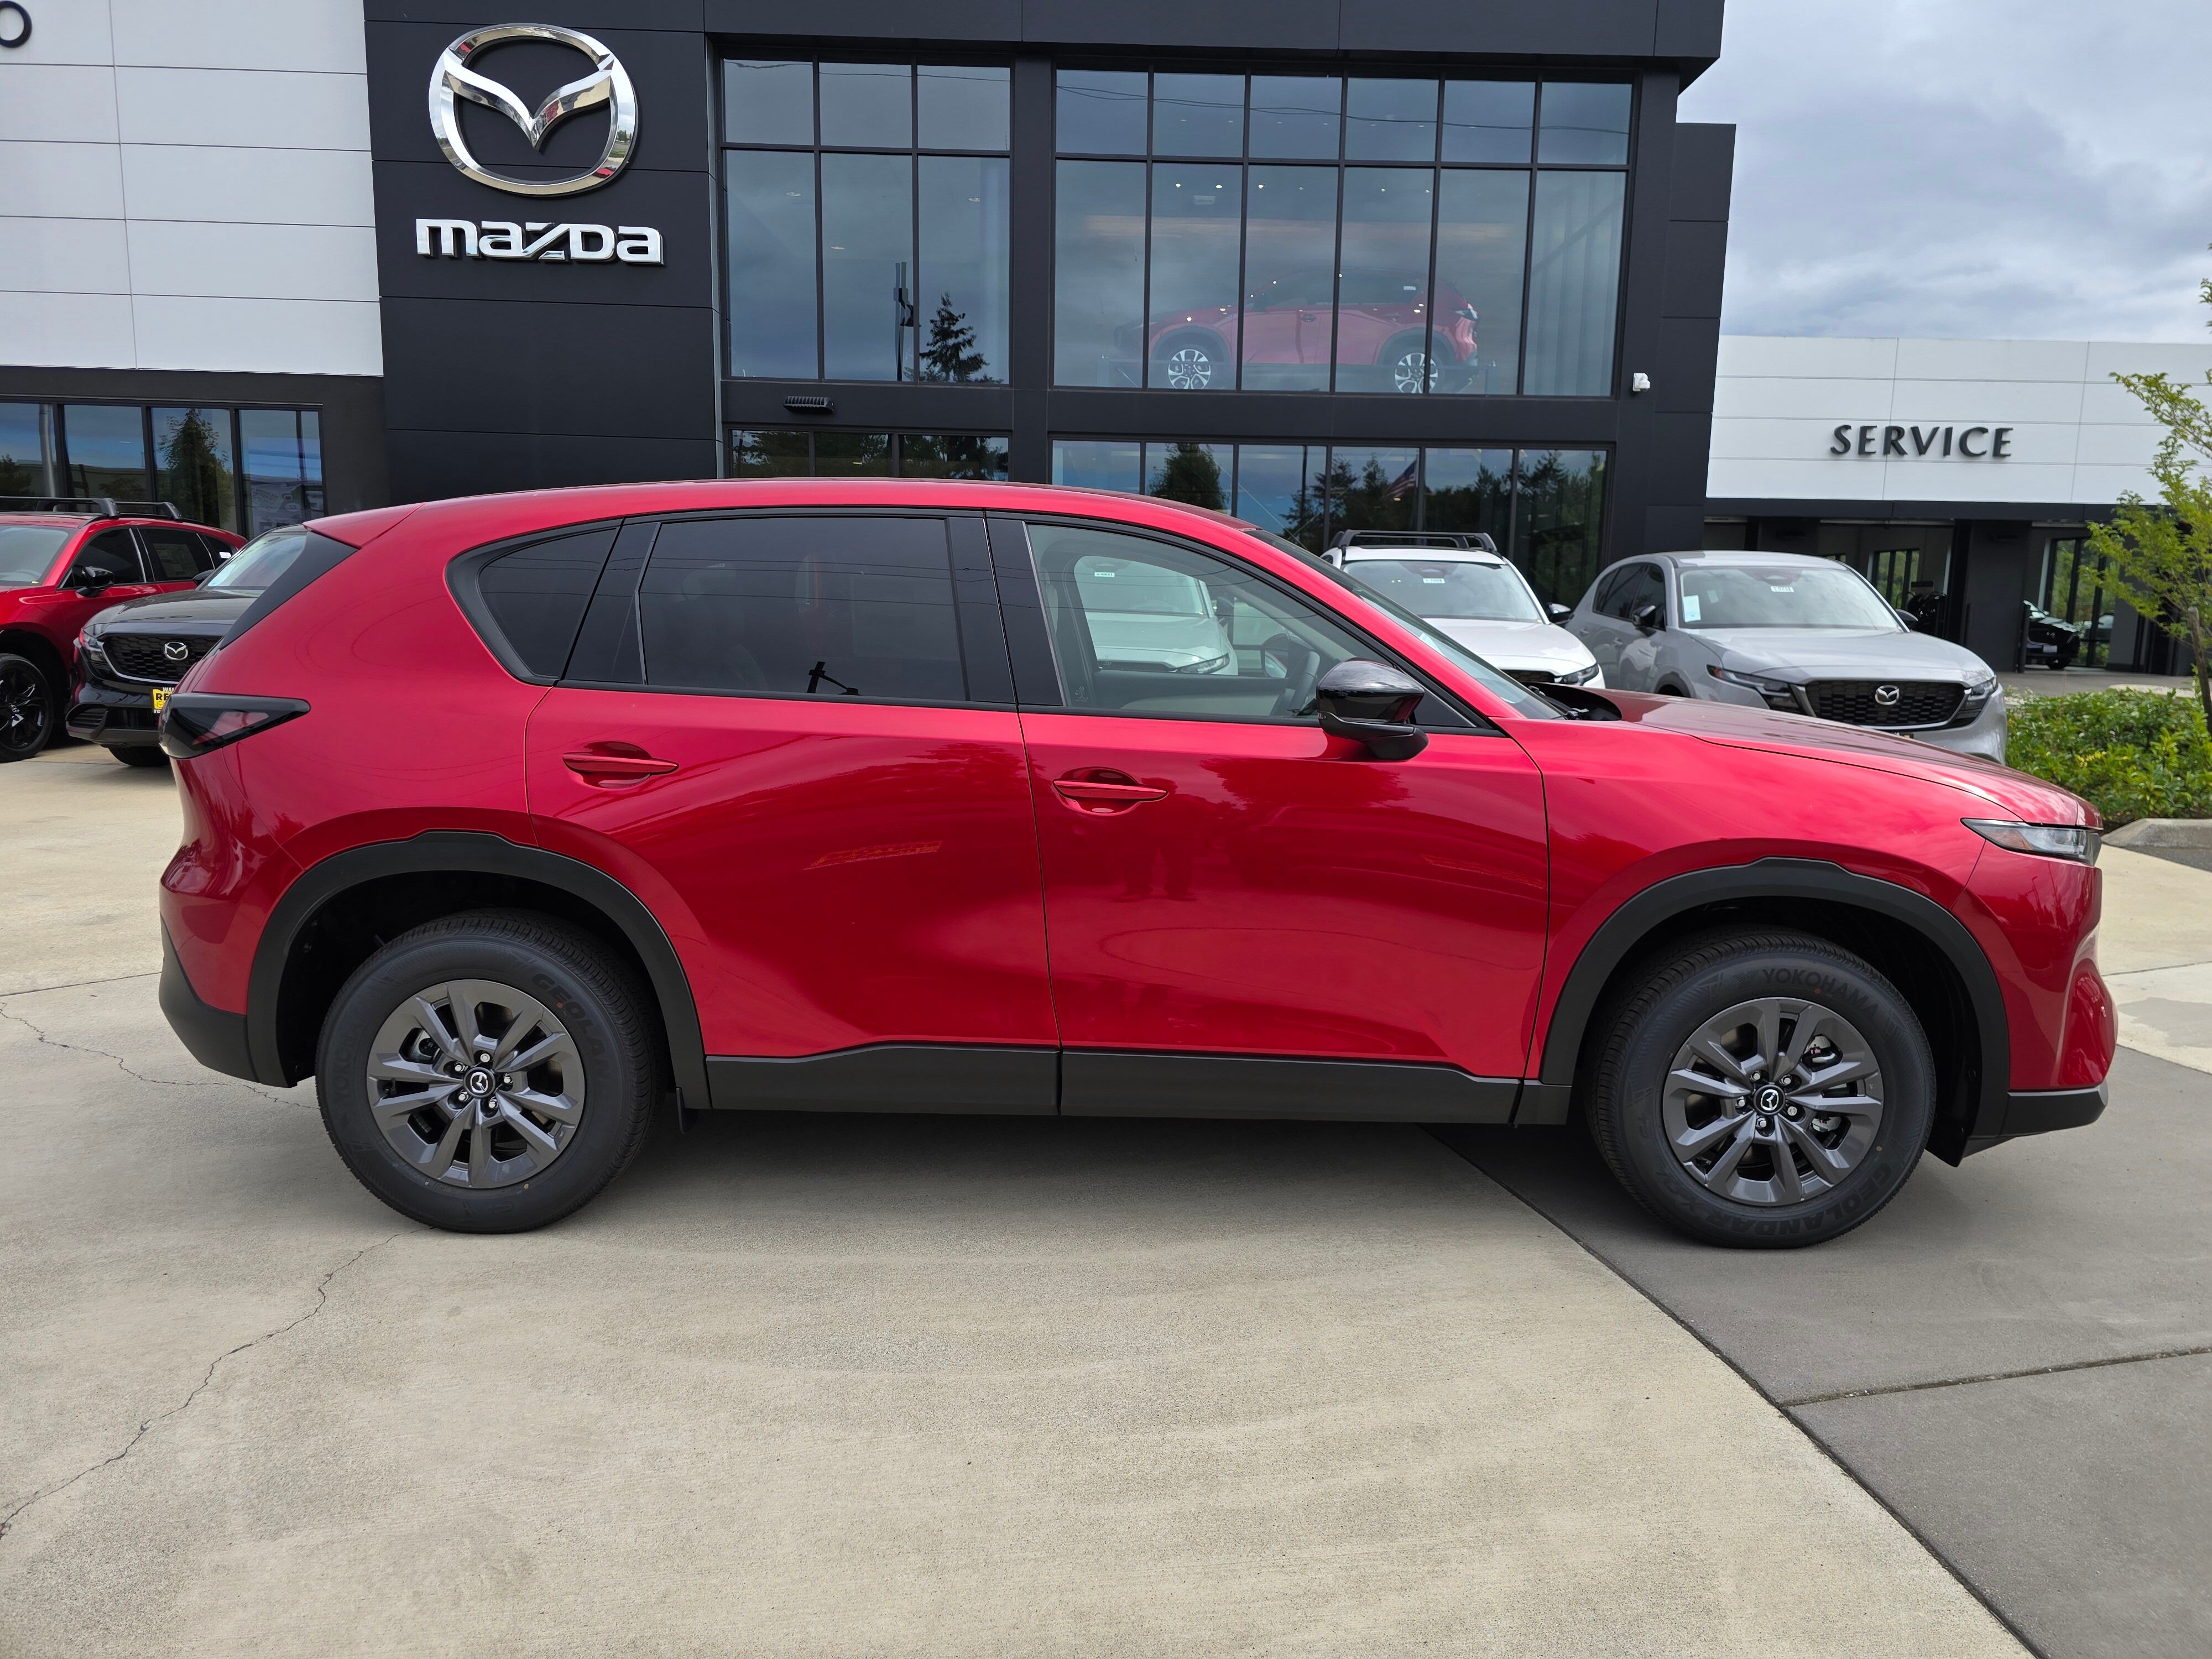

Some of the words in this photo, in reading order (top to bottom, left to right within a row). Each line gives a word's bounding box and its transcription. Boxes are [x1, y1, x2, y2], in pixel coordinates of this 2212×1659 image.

[1830, 424, 2013, 458] SERVICE
[1762, 968, 1879, 1018] YOKOHAMA
[1704, 1163, 1892, 1237] GEOLANDAR
